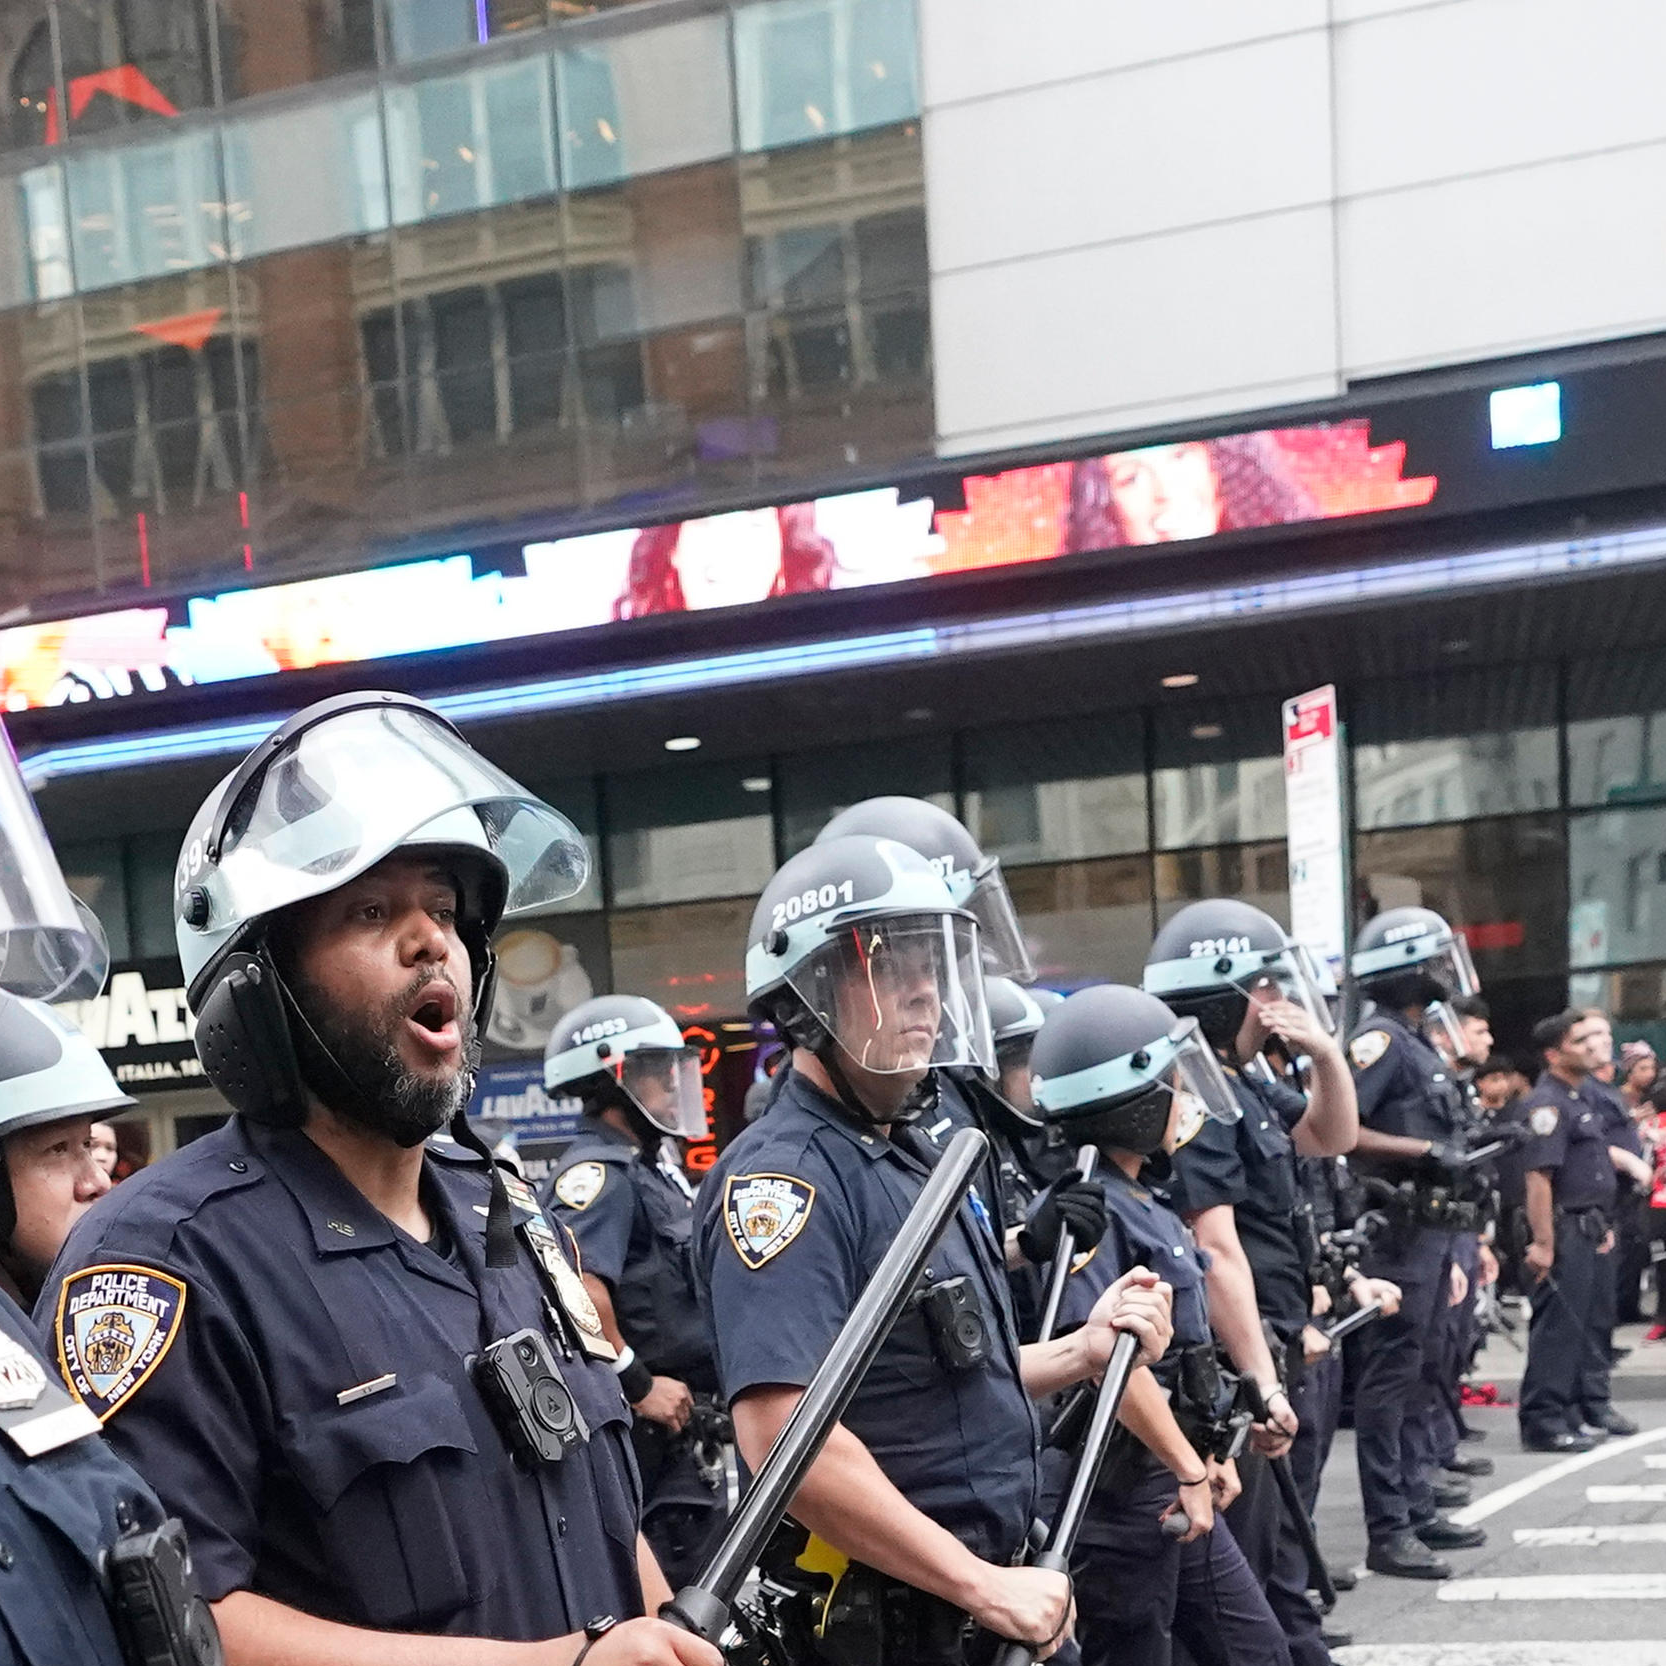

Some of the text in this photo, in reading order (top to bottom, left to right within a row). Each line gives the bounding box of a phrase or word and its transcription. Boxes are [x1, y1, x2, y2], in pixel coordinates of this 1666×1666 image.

[772, 880, 854, 929] 20801
[69, 1289, 170, 1318] DEPARTMENT
[91, 1273, 149, 1292] POLICE
[64, 1333, 92, 1397] CITY OF
[107, 1329, 167, 1404] NEW YORK
